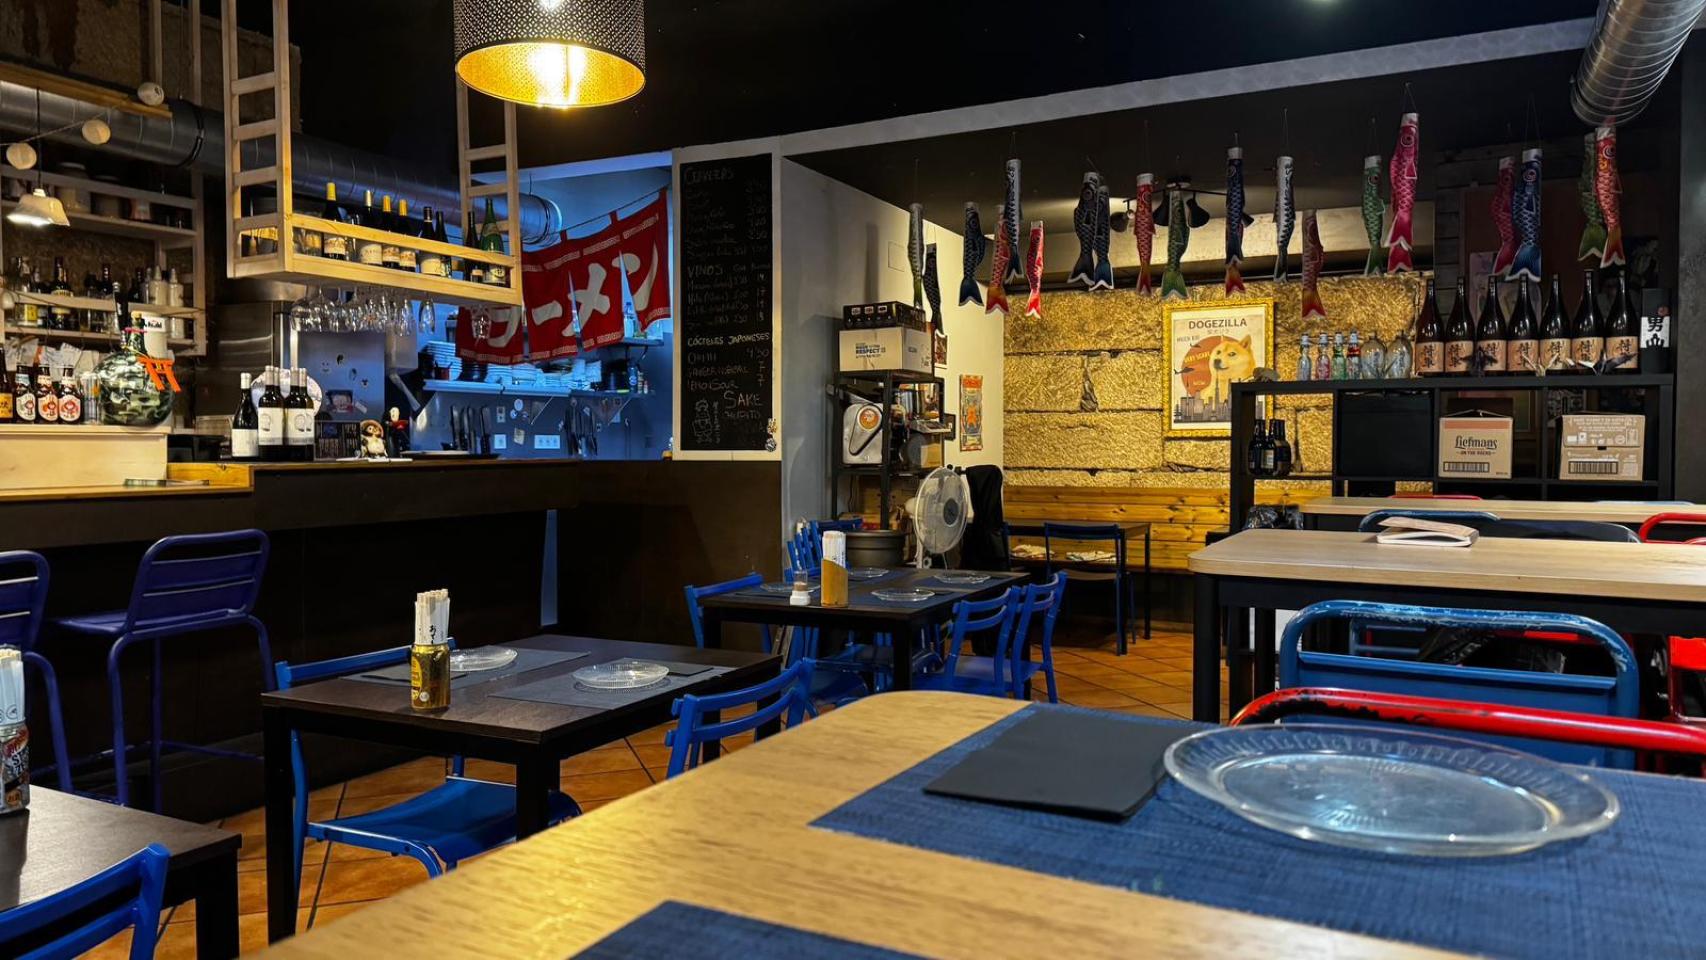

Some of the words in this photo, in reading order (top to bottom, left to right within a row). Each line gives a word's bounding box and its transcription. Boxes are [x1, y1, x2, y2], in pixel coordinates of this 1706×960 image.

[688, 263, 723, 278] VINOS
[1188, 318, 1247, 330] DOGEZILLA
[724, 390, 763, 409] SAKE
[1454, 435, 1498, 450] Liefmans
